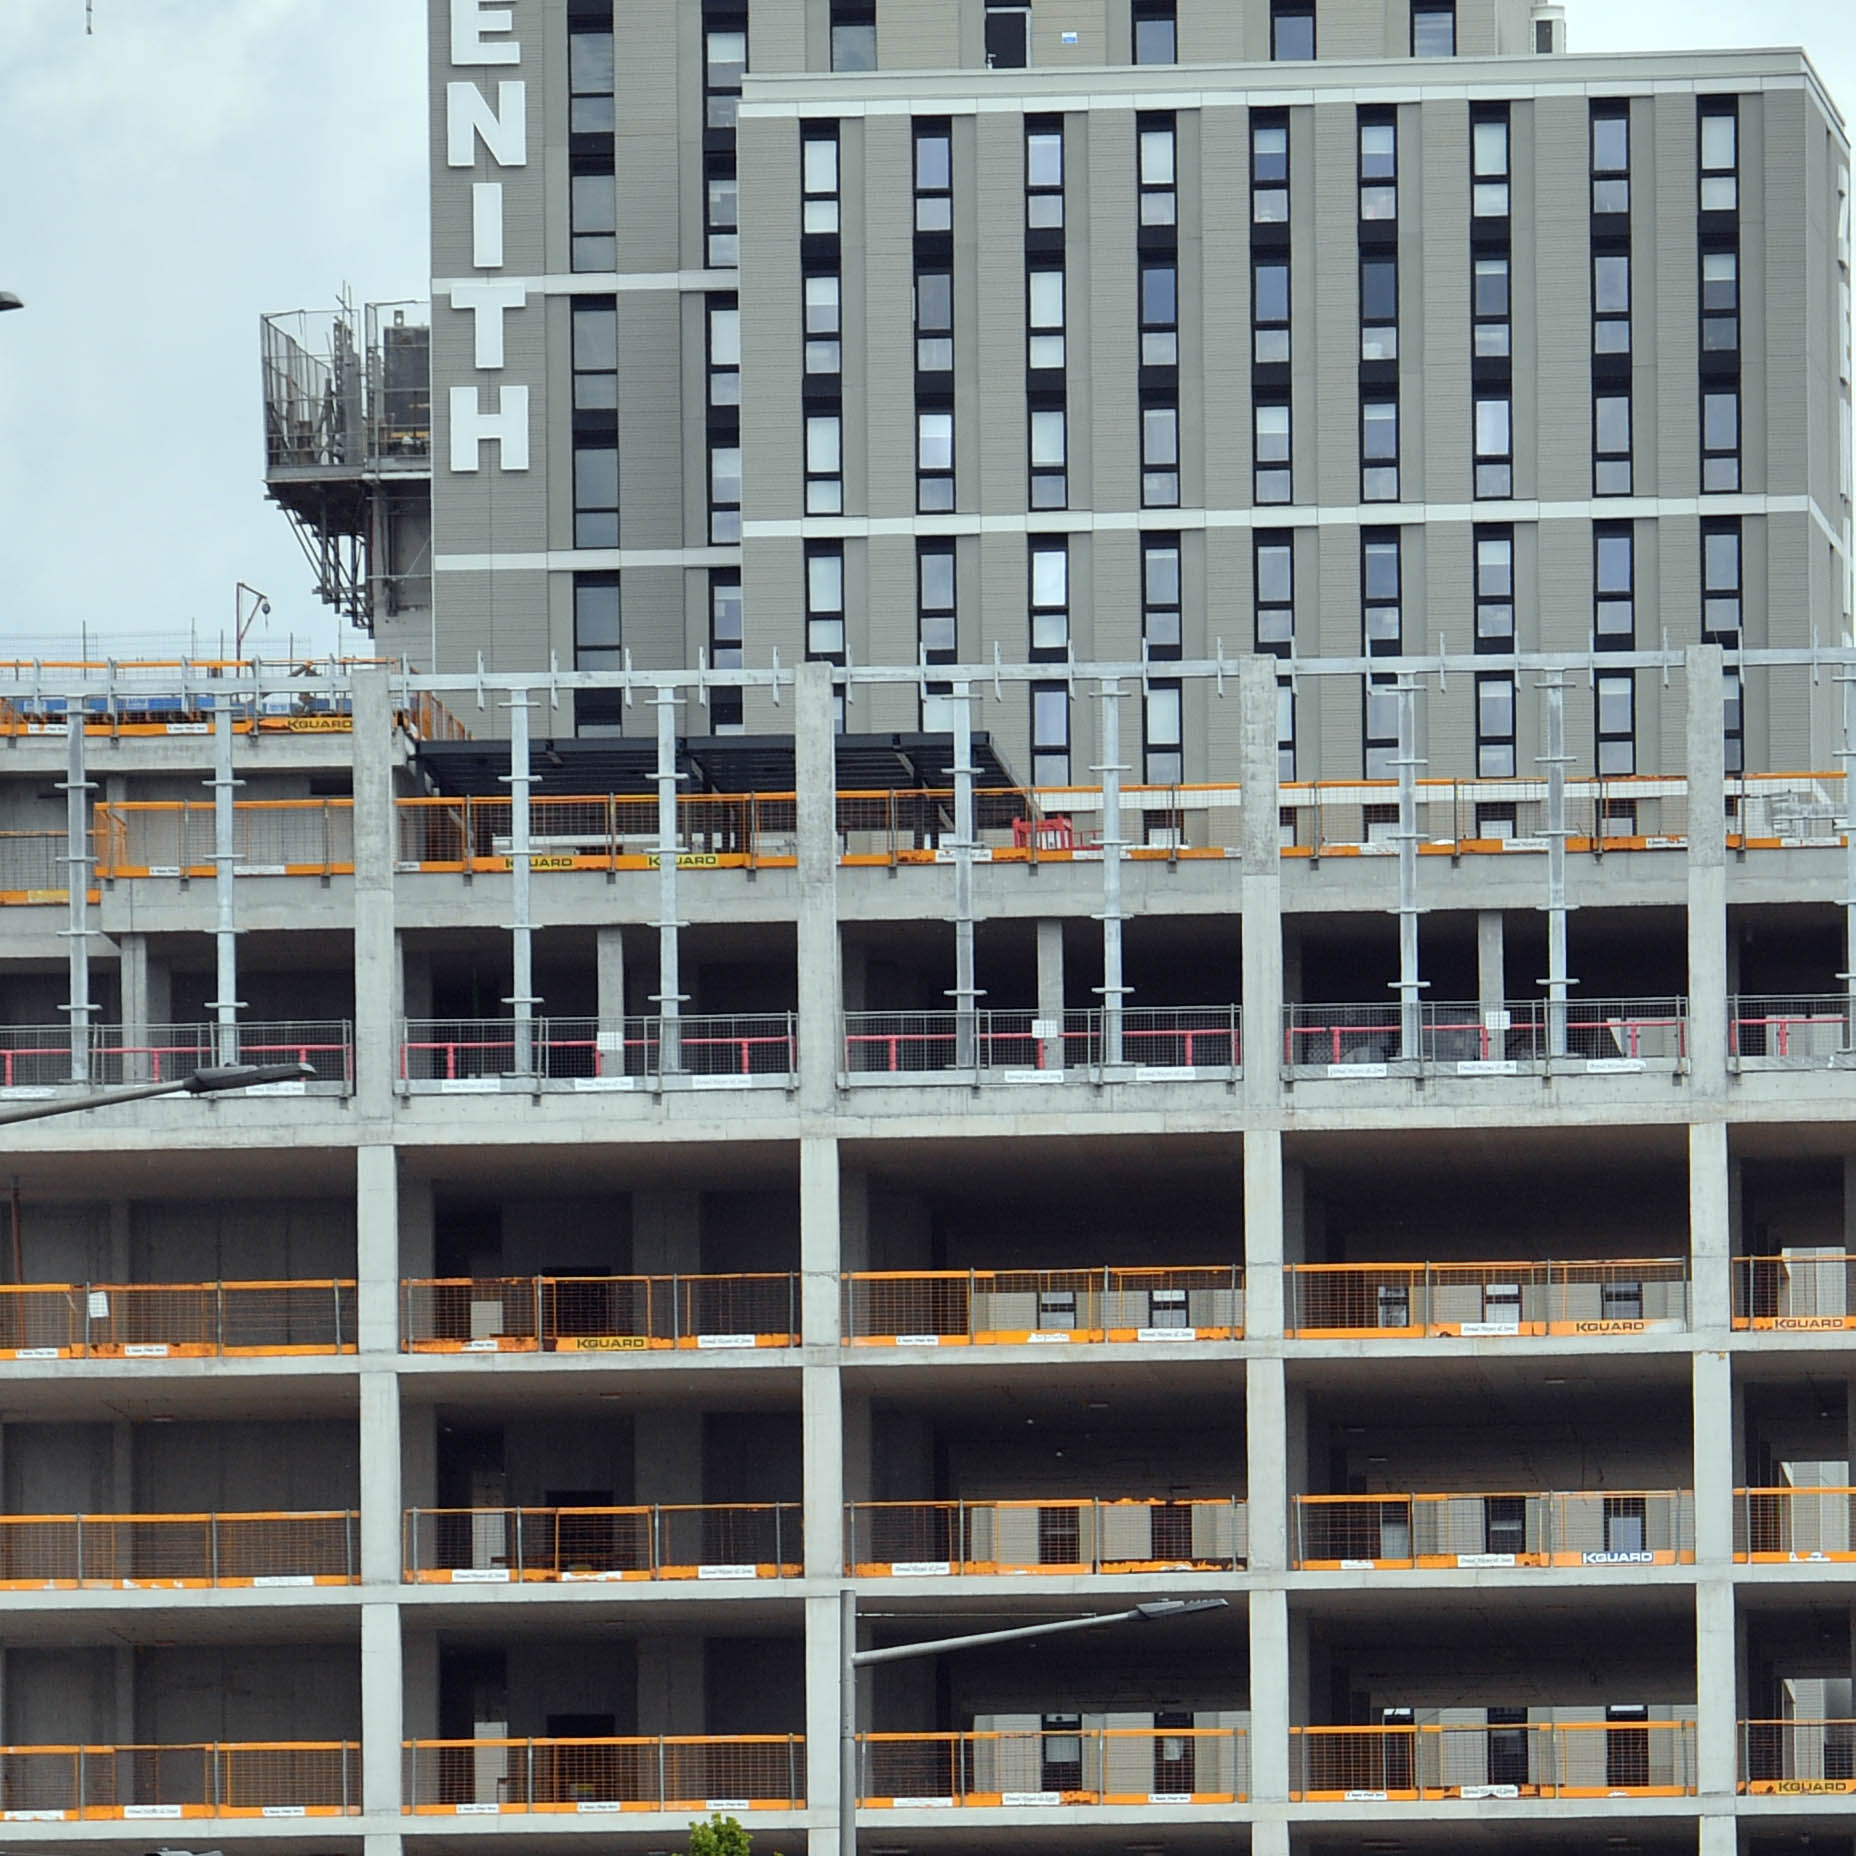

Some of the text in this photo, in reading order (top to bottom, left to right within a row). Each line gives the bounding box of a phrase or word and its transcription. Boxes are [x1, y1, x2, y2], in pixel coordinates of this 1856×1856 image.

[288, 719, 352, 729] KGUARD
[506, 858, 572, 868] KUARD
[649, 856, 716, 866] KARD
[1577, 1322, 1644, 1332] KGUARD
[1775, 1318, 1843, 1329] KGUARD
[577, 1338, 644, 1348] KGUARD
[1583, 1552, 1652, 1564] KGUARD
[1779, 1782, 1847, 1792] KGUARD
